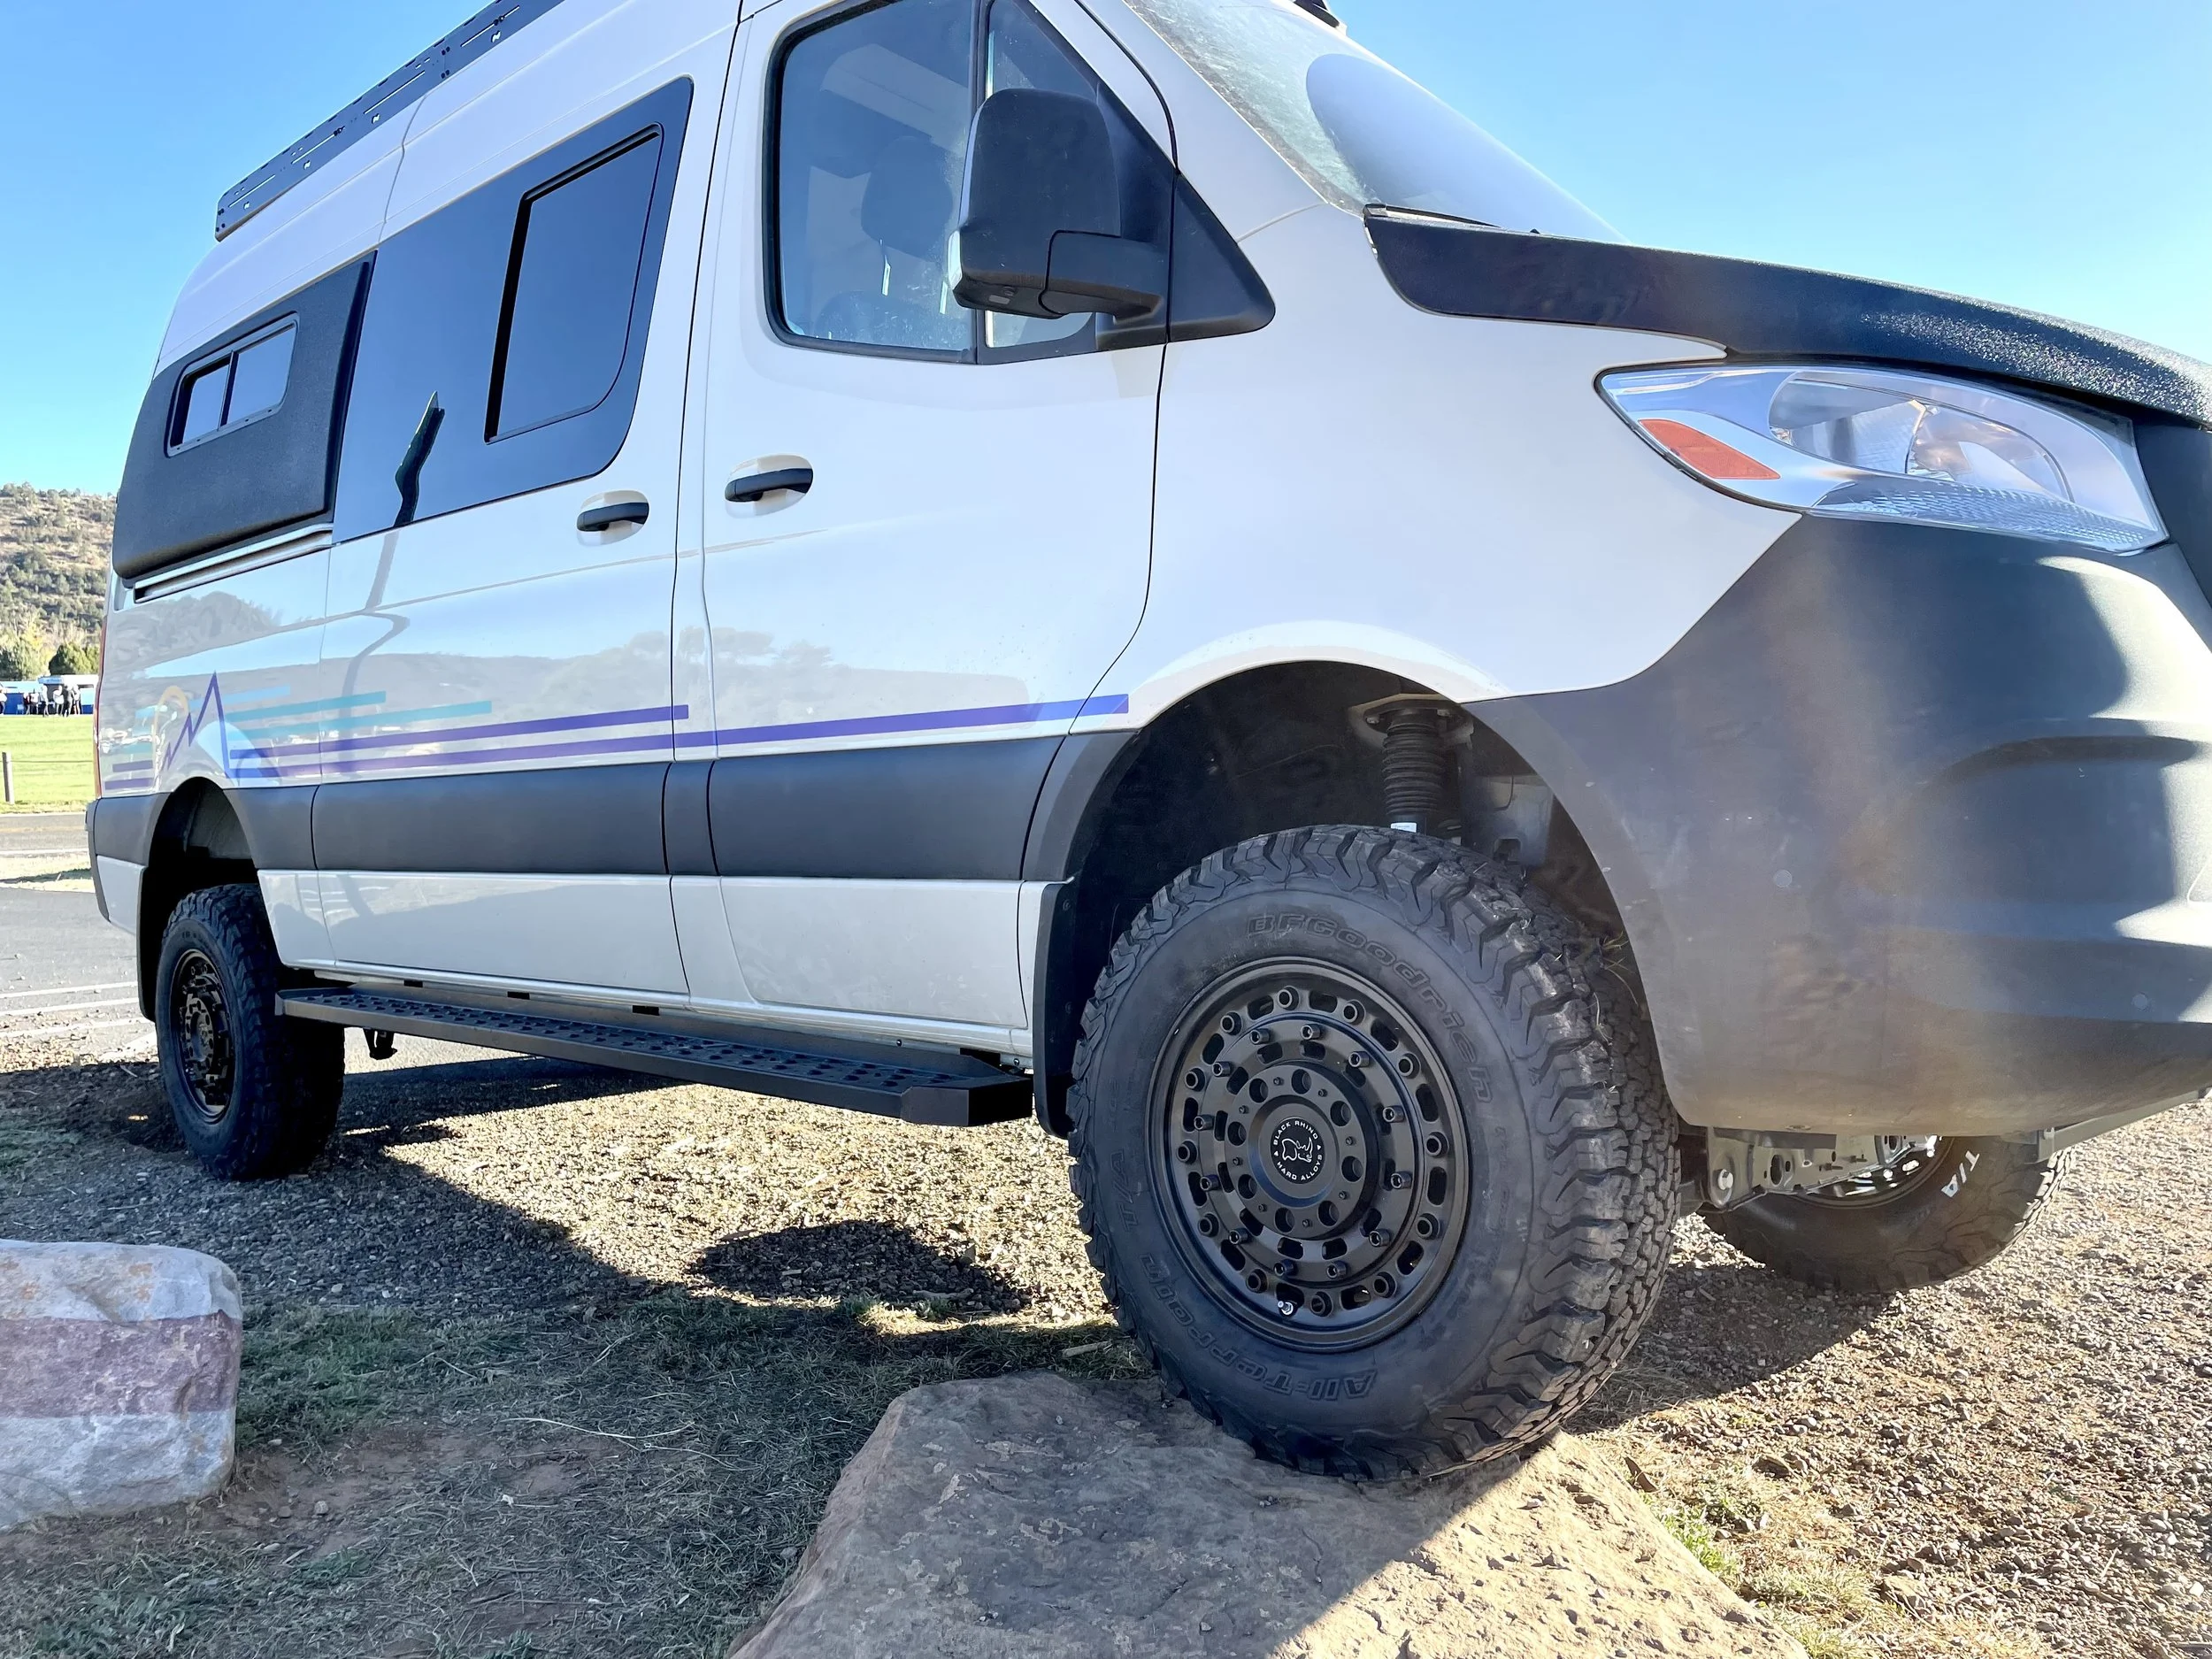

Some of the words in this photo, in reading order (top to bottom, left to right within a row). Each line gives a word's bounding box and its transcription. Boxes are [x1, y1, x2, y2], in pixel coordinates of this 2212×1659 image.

[1247, 912, 1494, 1103] BFGoodrich
[1273, 1121, 1291, 1146] BLACK
[1294, 1120, 1318, 1141] RHINO
[1277, 1161, 1297, 1180] HARD
[1301, 1154, 1323, 1181] ALLOYS
